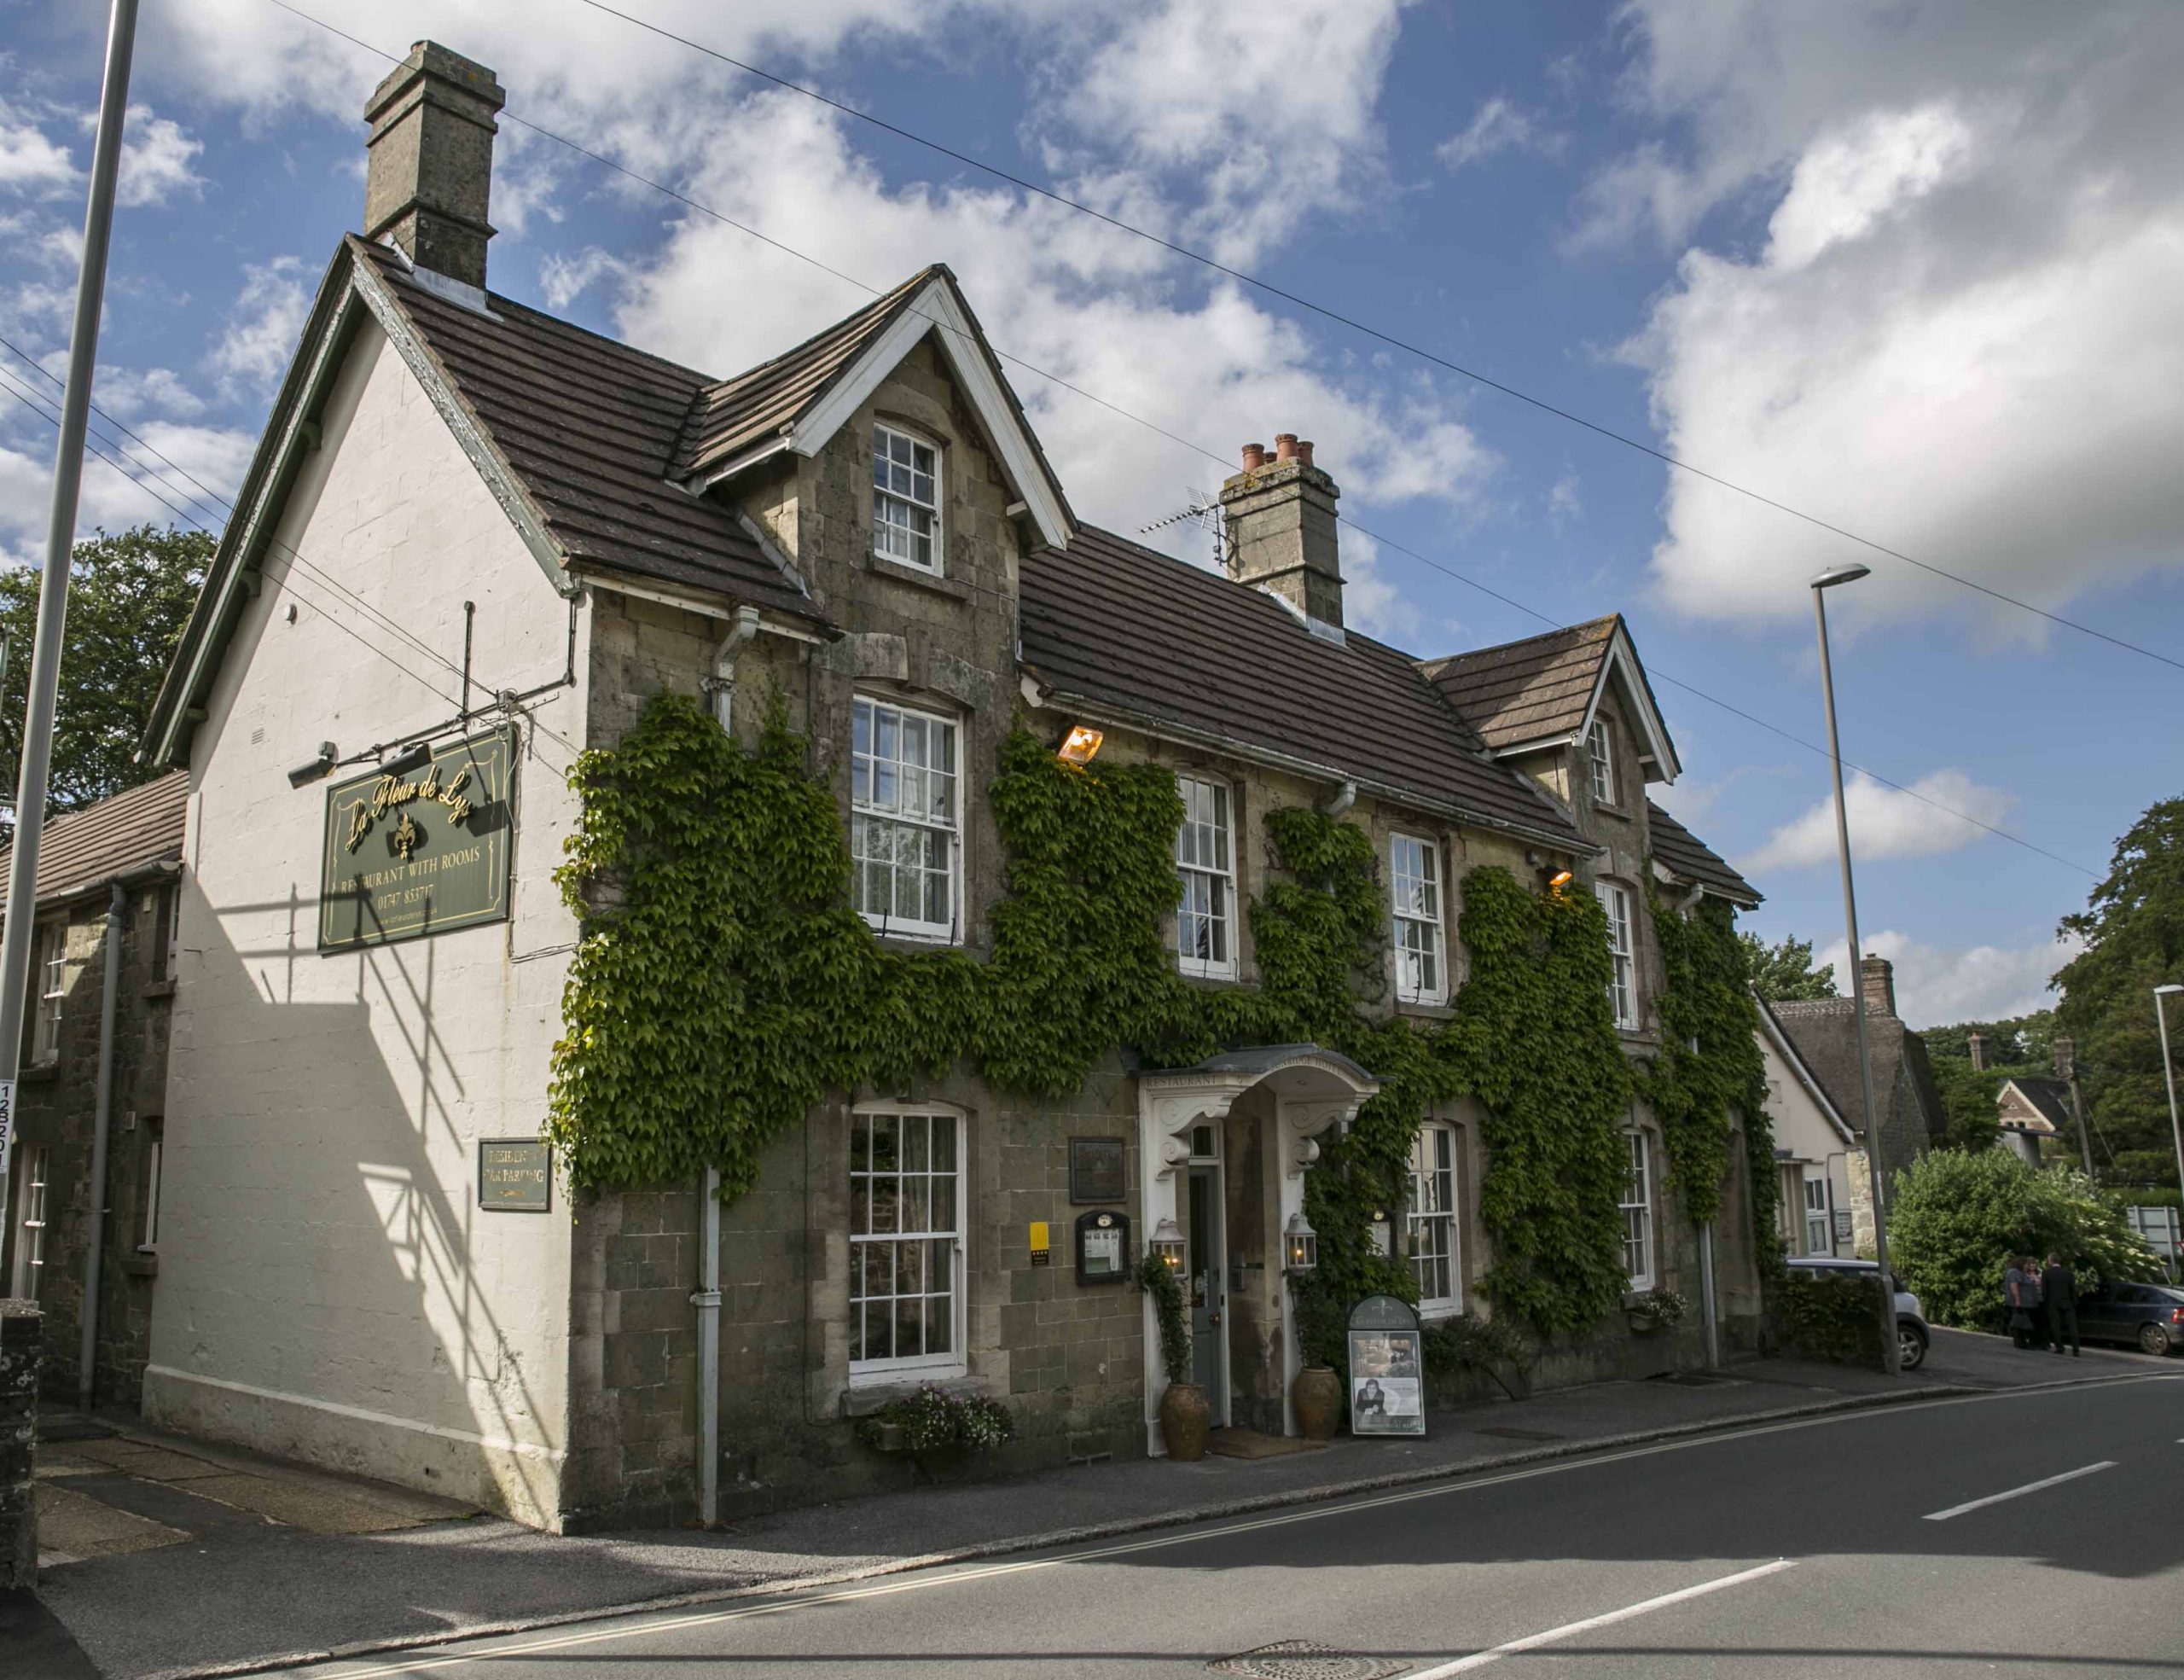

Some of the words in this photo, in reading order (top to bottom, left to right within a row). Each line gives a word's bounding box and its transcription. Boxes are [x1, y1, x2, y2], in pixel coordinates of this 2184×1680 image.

[345, 800, 368, 851] La
[372, 775, 416, 817] Fleur
[419, 764, 438, 798] de
[439, 770, 471, 823] Lys
[342, 865, 405, 892] RESAURANT
[409, 857, 438, 878] WITH
[442, 846, 480, 869] ROOMS
[378, 892, 401, 910] 01747
